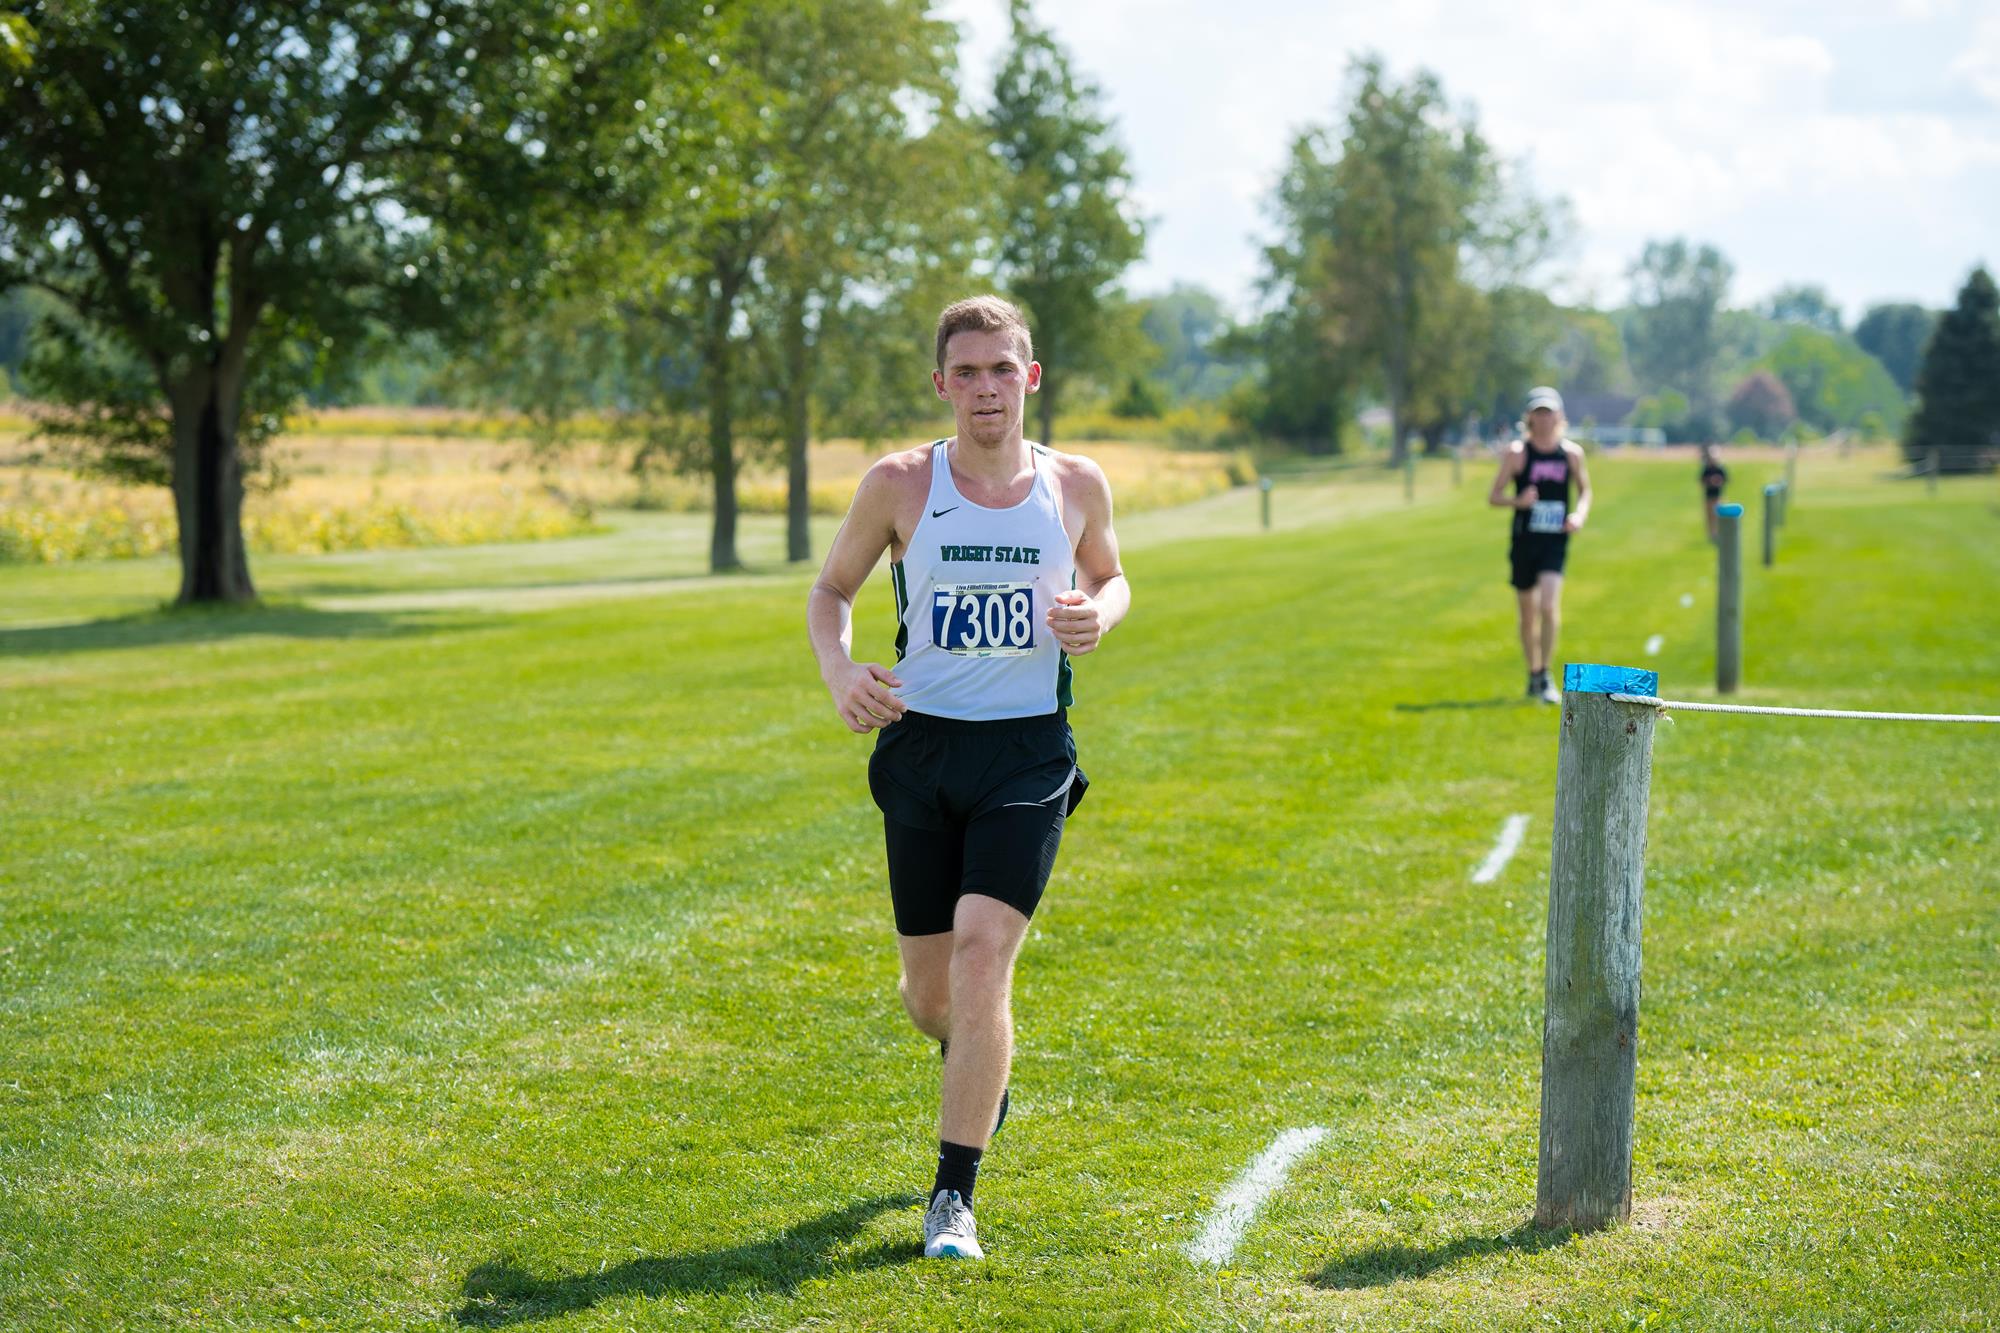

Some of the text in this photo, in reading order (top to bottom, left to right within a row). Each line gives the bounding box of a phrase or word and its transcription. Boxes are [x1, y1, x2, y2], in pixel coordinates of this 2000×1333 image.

[940, 545, 1041, 565] WRIGHT STATE
[935, 592, 1031, 648] 7308
